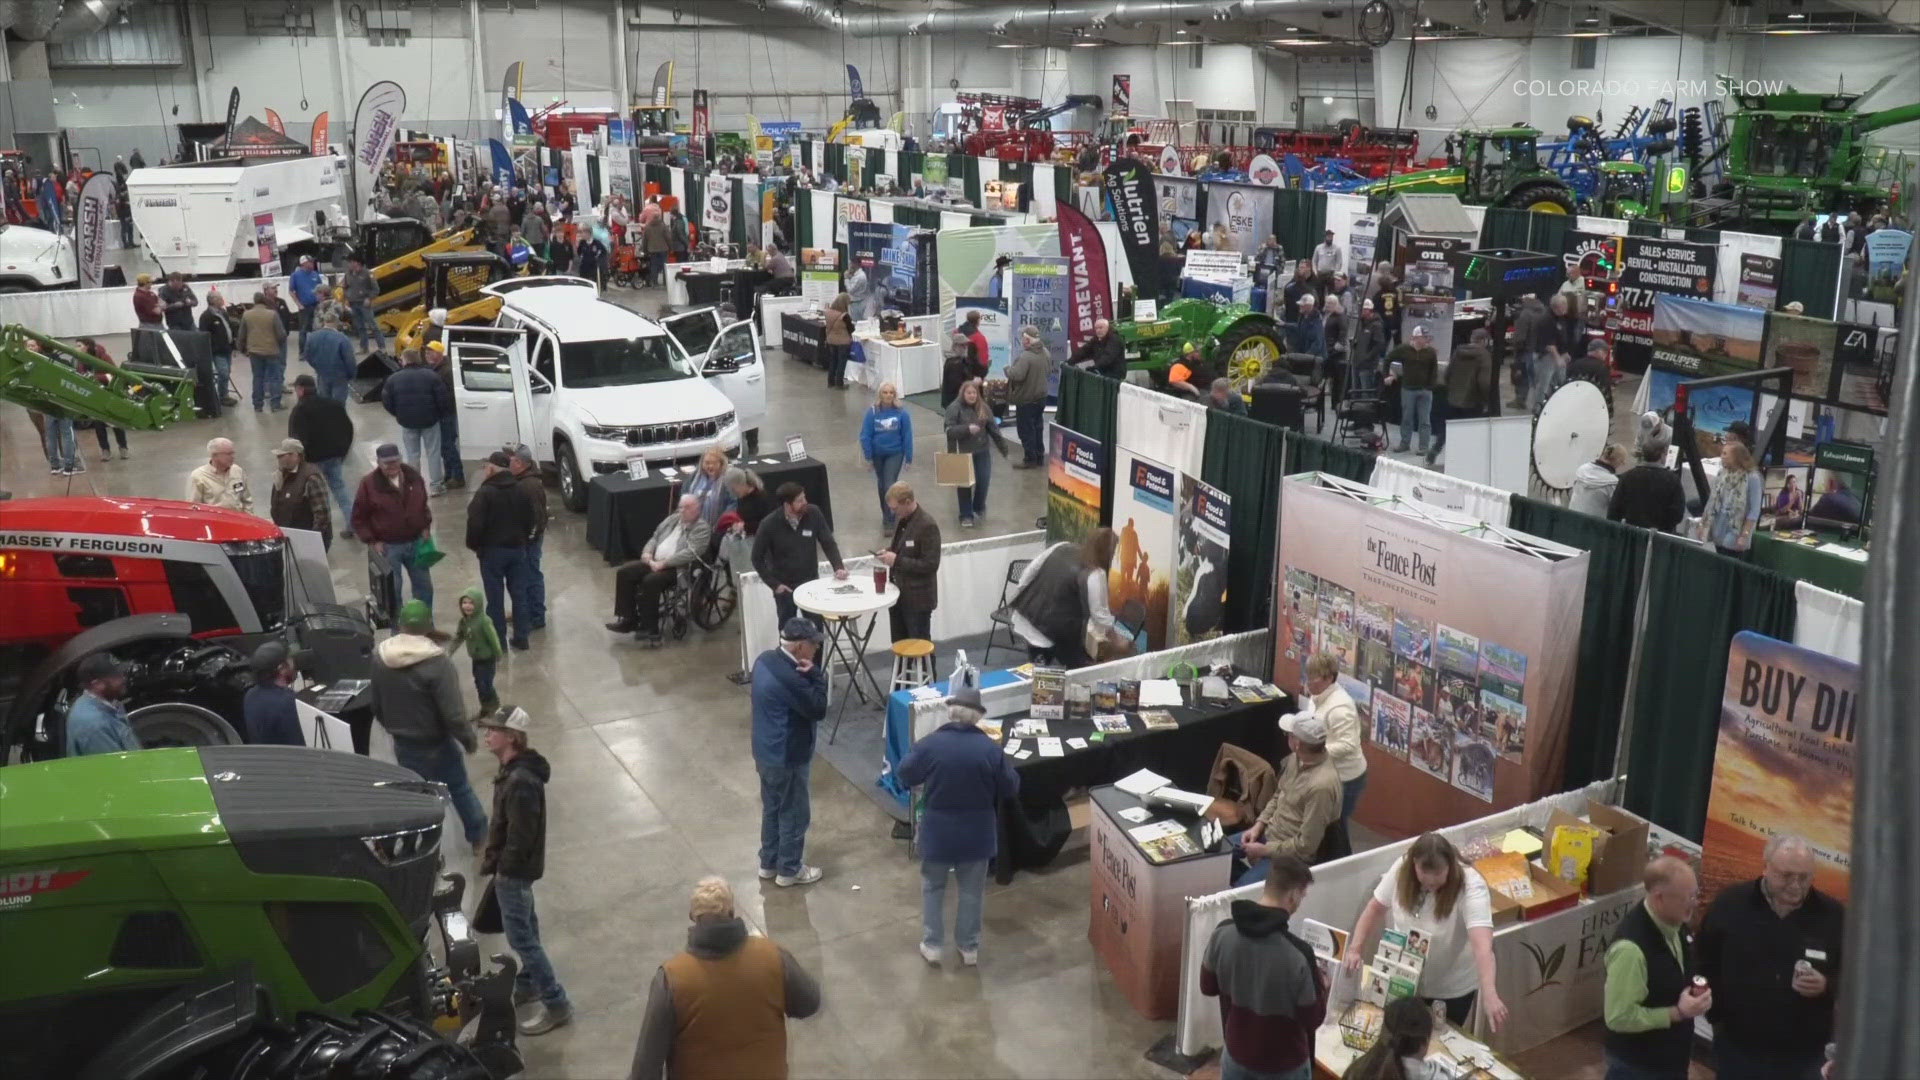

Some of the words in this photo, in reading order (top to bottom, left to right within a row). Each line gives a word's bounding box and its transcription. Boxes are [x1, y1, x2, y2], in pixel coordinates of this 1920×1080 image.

[357, 109, 392, 167] HARSH
[848, 202, 867, 222] PGS
[1107, 173, 1115, 187] Ag
[1111, 188, 1129, 232] Solutions
[1119, 168, 1151, 246] Nutrien
[83, 196, 99, 264] HARSH
[1421, 251, 1445, 261] OTR
[1576, 239, 1606, 255] SCAL
[1639, 245, 1661, 258] SALES
[1666, 247, 1697, 262] SERVICE
[1627, 257, 1653, 270] RENTAL
[1657, 259, 1707, 277] INSTALLATION
[1022, 278, 1051, 289] TITAN
[1069, 232, 1094, 332] BREVANT
[1638, 271, 1692, 289] CONSTRUCTION
[980, 312, 998, 322] ract
[1621, 333, 1634, 344] AND
[1075, 455, 1098, 470] Peterson
[1076, 446, 1090, 460] Flood
[1146, 471, 1162, 485] Flood
[1145, 480, 1170, 497] Peterson
[1205, 500, 1219, 515] Flood
[1204, 511, 1227, 528] Peterson
[70, 538, 164, 554] FERGUSON
[1367, 536, 1377, 553] the
[1376, 539, 1410, 577] Fence
[1411, 551, 1437, 587] Post
[1740, 658, 1807, 722] BUY
[1744, 714, 1797, 739] Agricultural
[1800, 731, 1819, 746] Real
[1823, 741, 1849, 758] Estate
[1730, 812, 1747, 826] Talk
[1749, 820, 1757, 831] to
[1811, 847, 1832, 860] more
[1122, 858, 1137, 901] Post
[1581, 901, 1633, 936] FIRST
[1578, 933, 1607, 970] FA
